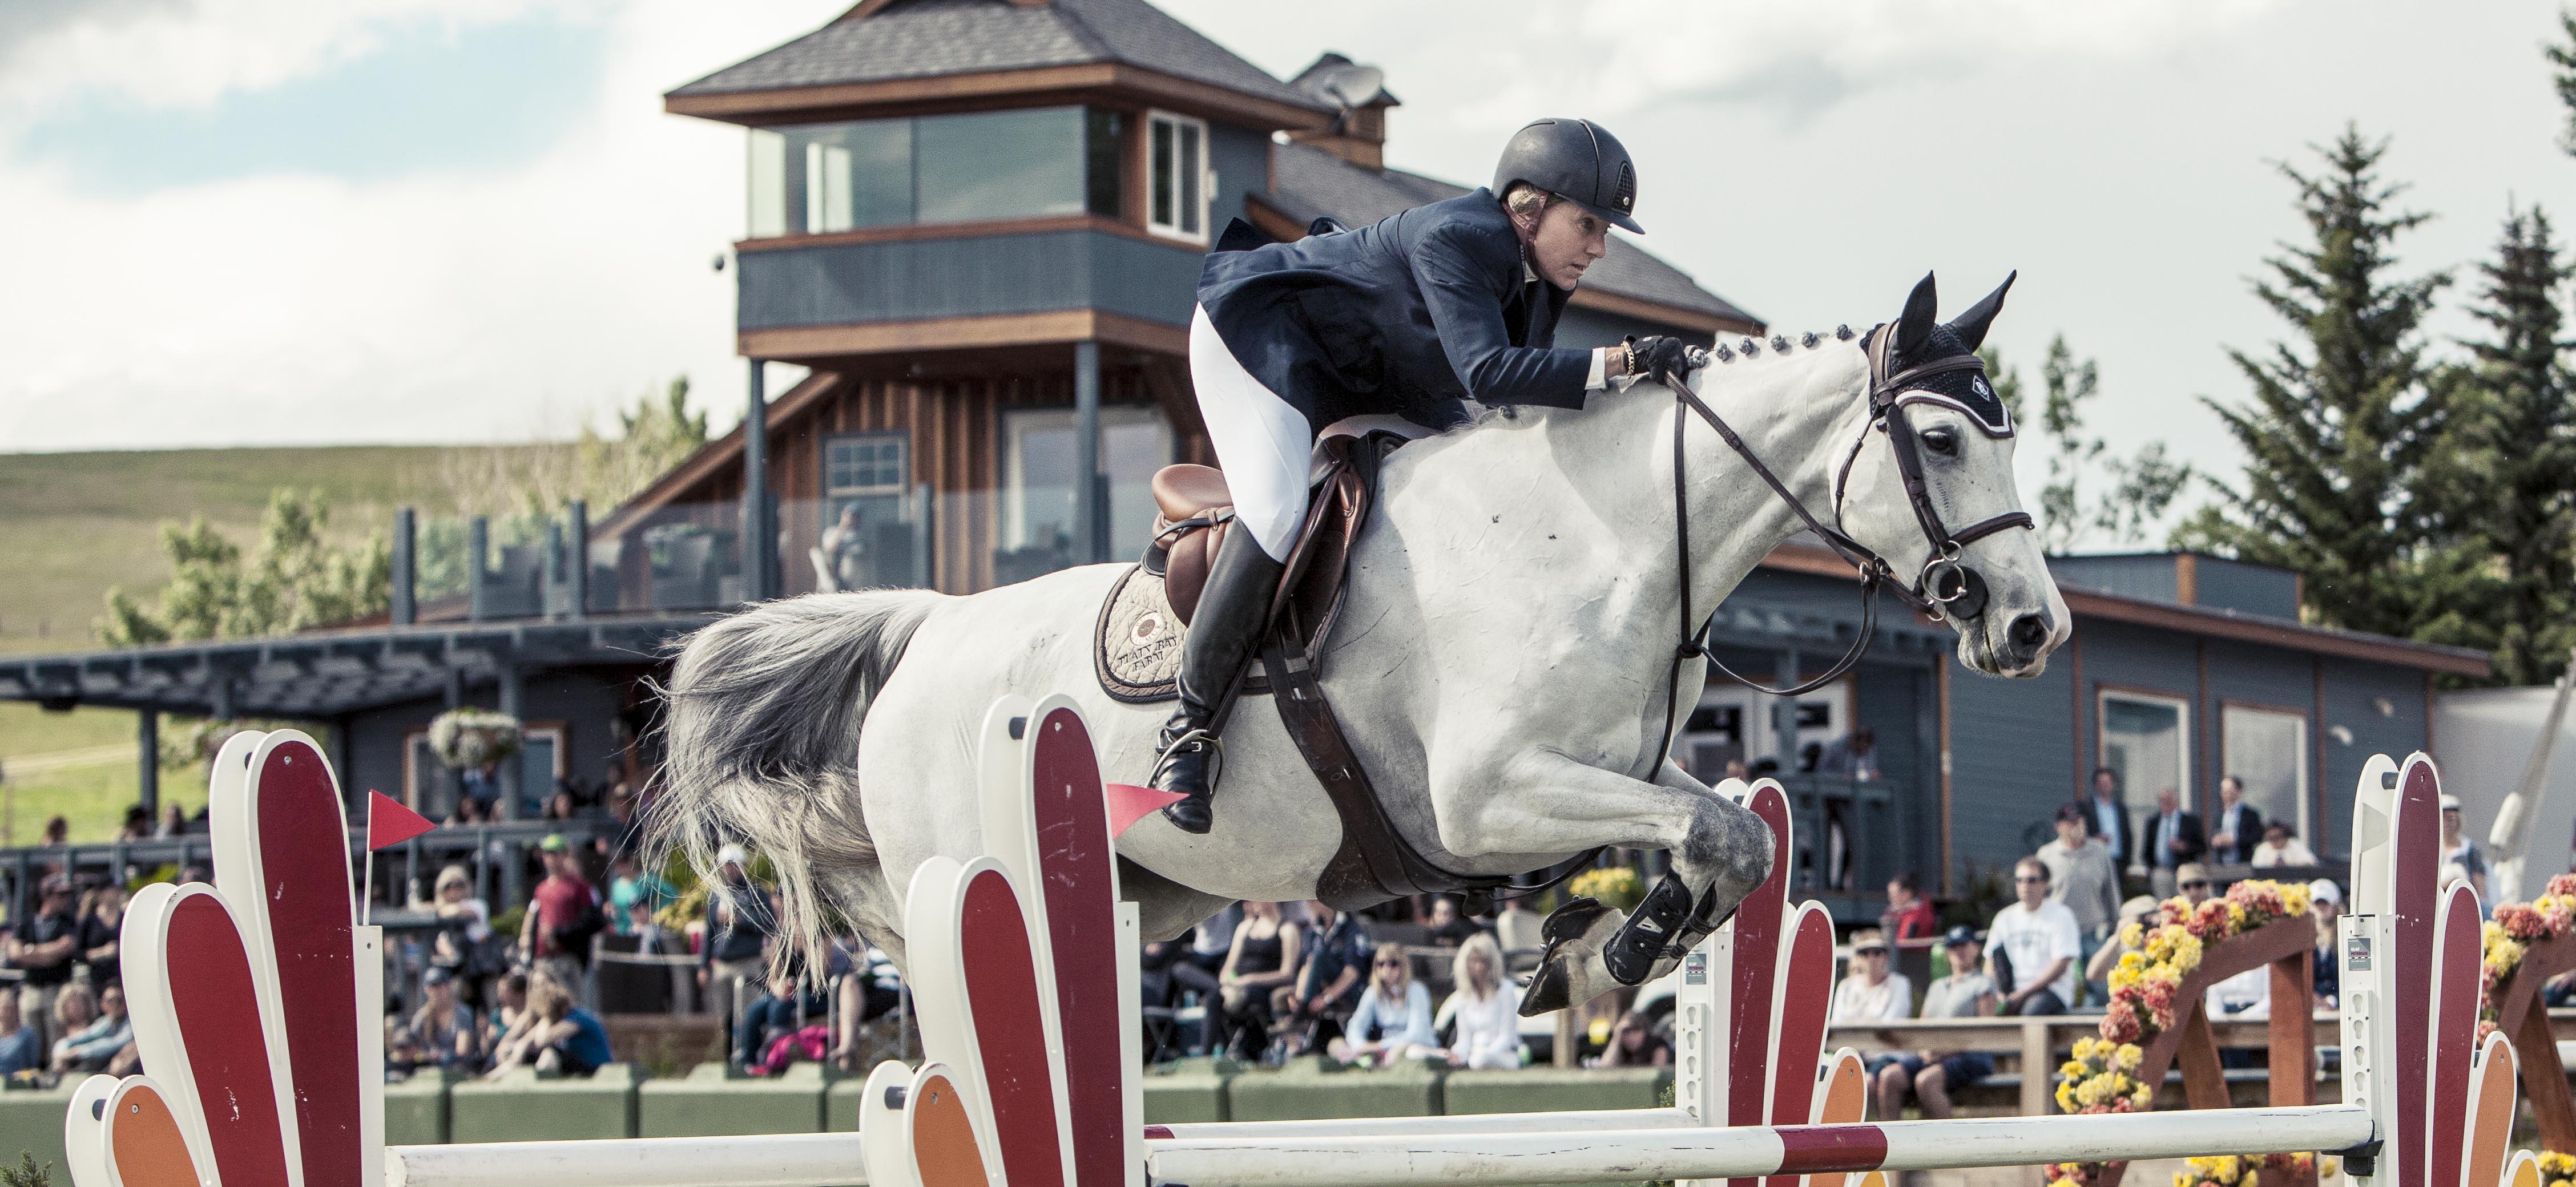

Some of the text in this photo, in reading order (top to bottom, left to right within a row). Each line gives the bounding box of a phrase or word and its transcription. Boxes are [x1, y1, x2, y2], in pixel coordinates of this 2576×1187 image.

[1118, 636, 1177, 666] PLAIN BAY
[1132, 651, 1163, 671] FARM
